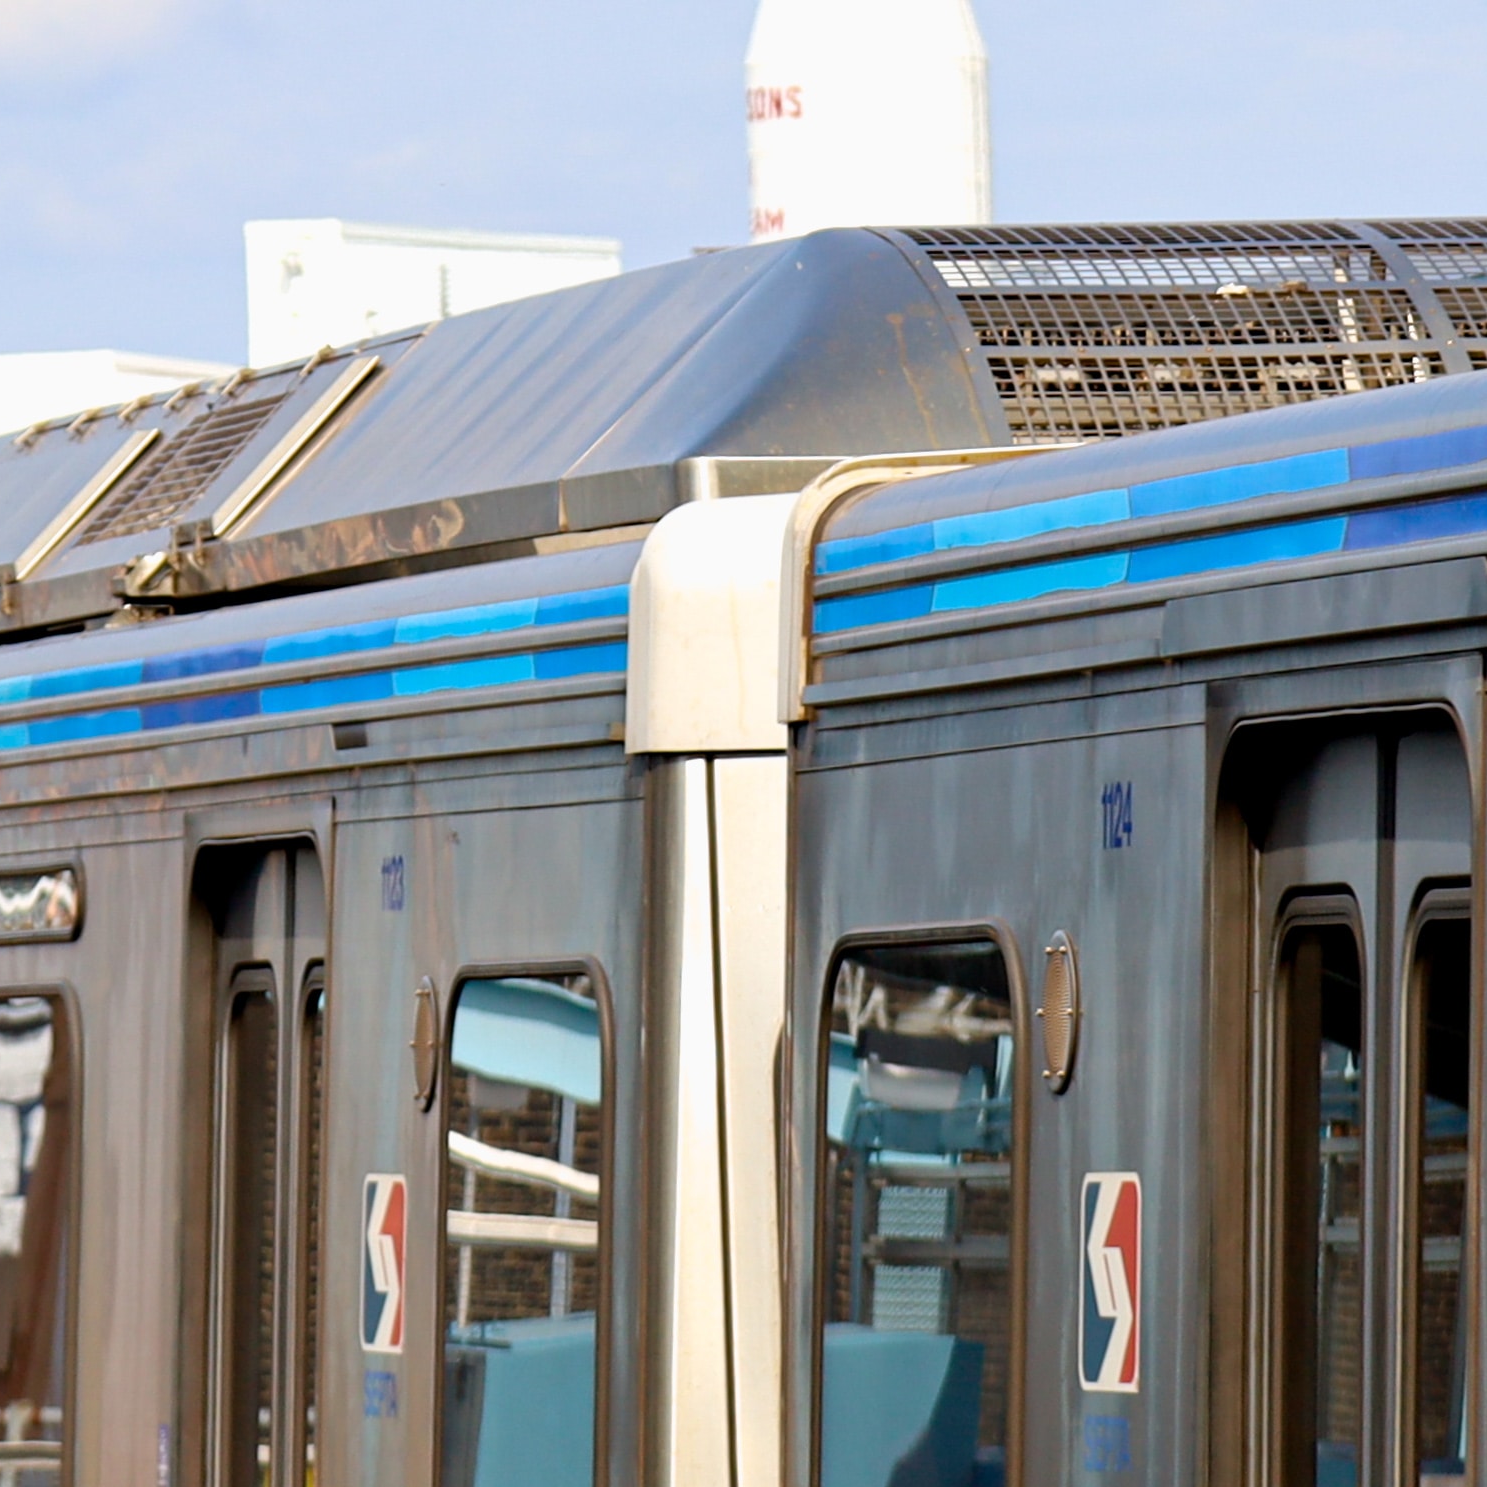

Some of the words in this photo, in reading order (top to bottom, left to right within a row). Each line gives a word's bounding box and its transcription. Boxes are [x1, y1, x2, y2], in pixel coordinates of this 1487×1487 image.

[1101, 781, 1133, 849] 1124
[381, 854, 405, 911] 1123
[1084, 1414, 1132, 1472] SEPTA
